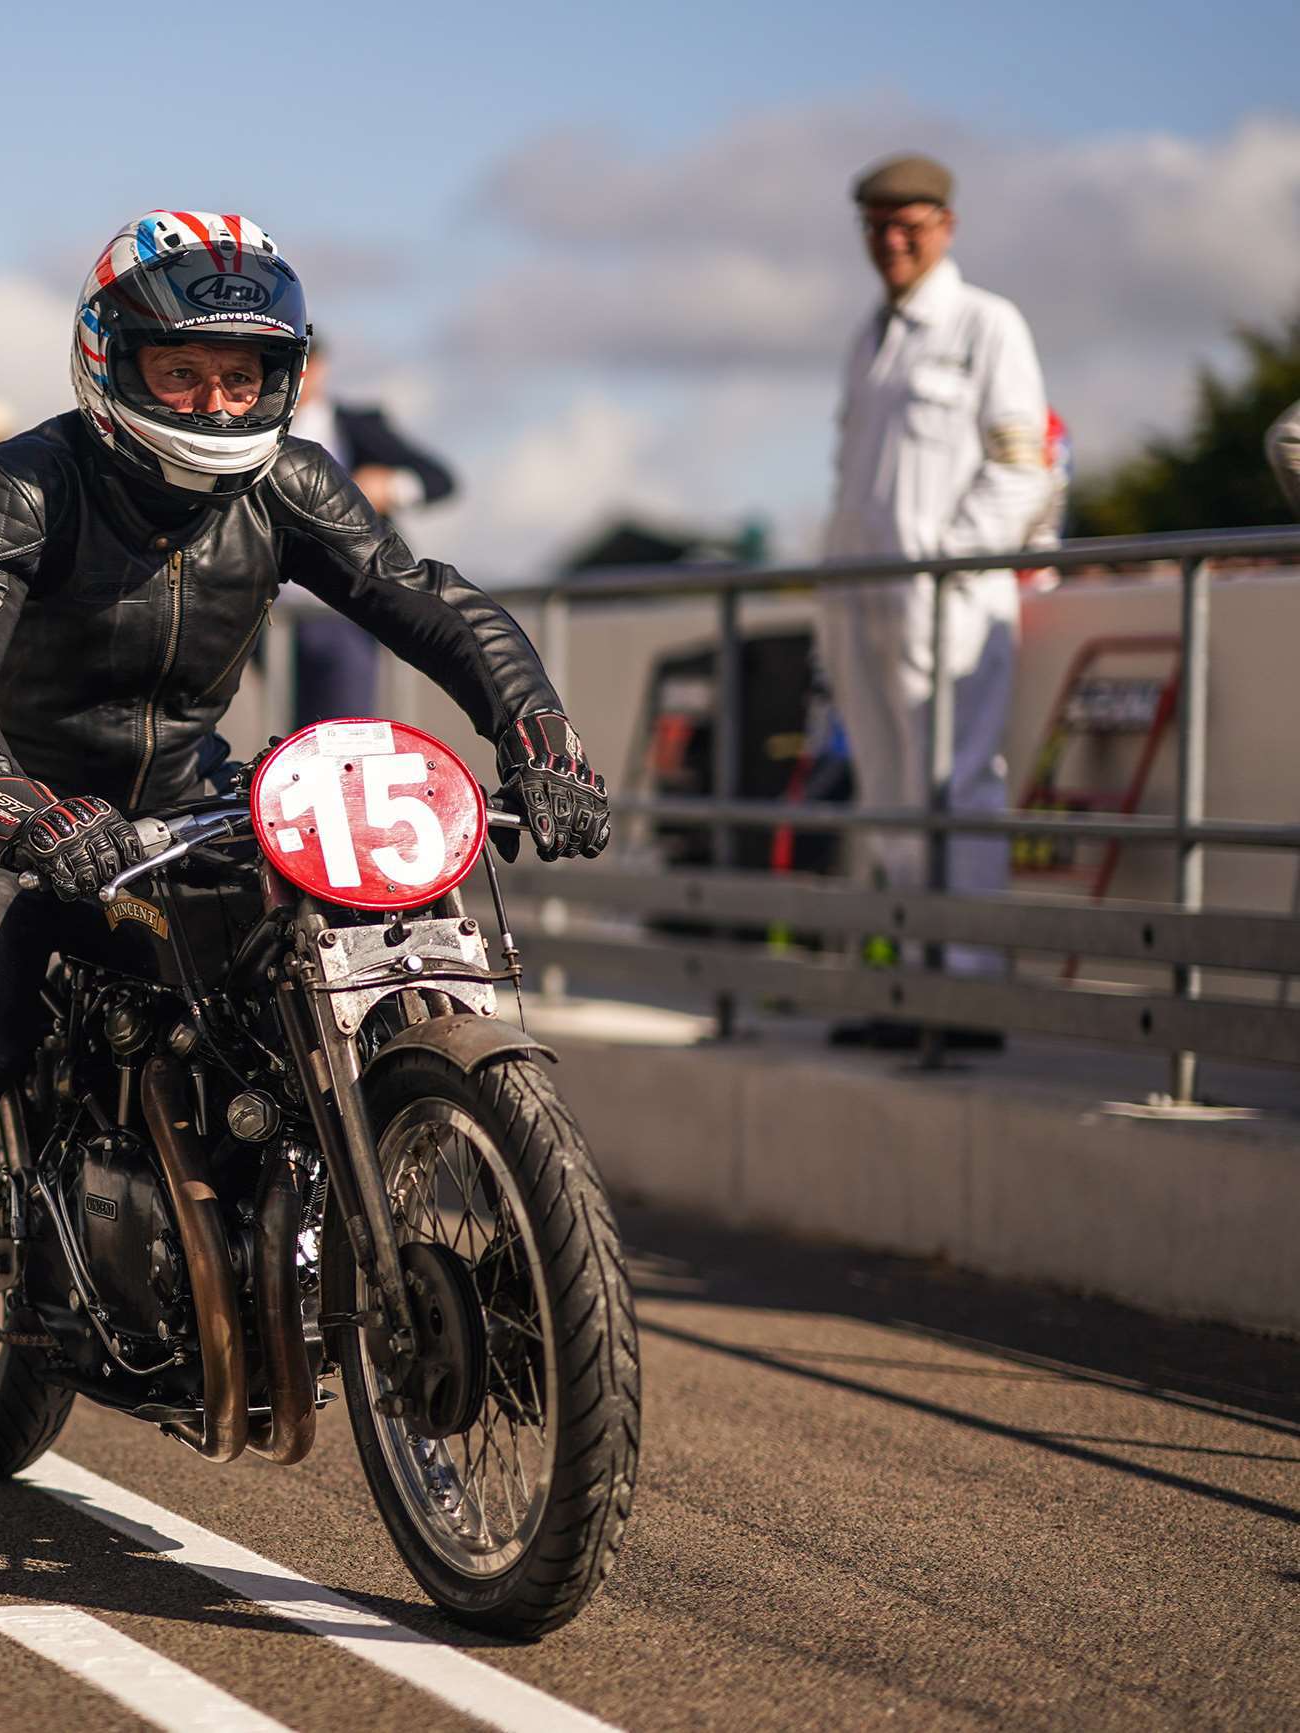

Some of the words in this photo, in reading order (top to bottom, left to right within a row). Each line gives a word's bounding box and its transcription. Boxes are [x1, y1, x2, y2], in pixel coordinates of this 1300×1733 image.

[194, 277, 264, 302] Arai
[174, 311, 296, 334] www.steveplater.com
[279, 752, 446, 888] 15
[111, 902, 156, 924] VINCENT
